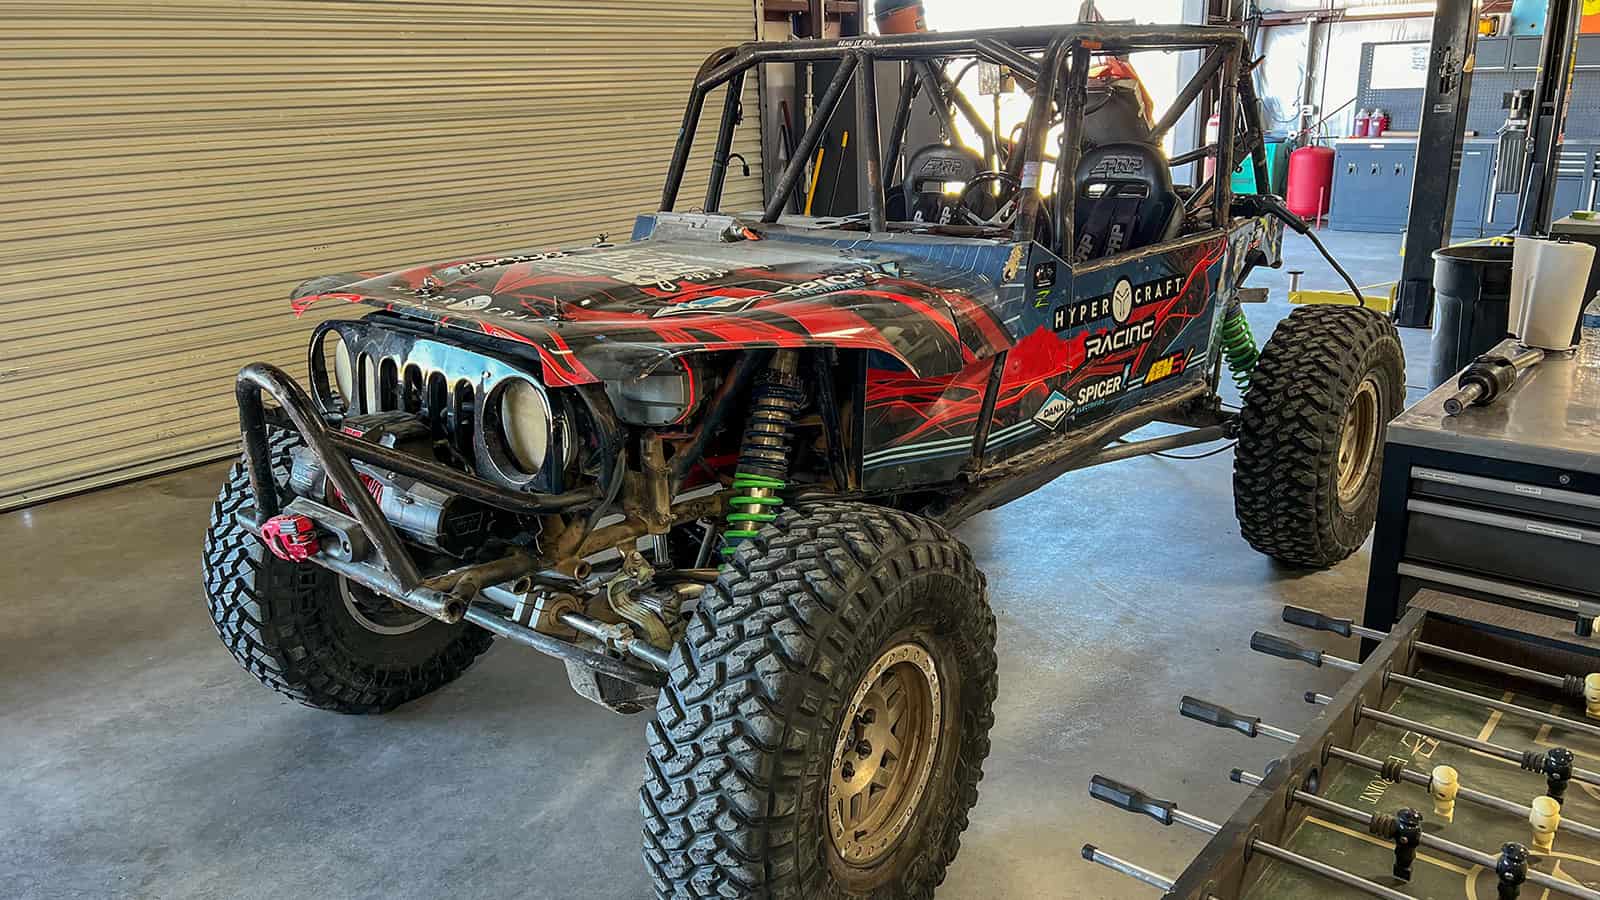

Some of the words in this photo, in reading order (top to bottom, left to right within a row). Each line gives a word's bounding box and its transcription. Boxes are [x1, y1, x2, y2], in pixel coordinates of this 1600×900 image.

[1055, 299, 1109, 329] HYPER
[1135, 278, 1183, 304] CRAFT
[1086, 320, 1154, 359] RACING
[1043, 402, 1066, 418] DANA
[1077, 376, 1122, 406] SPICER
